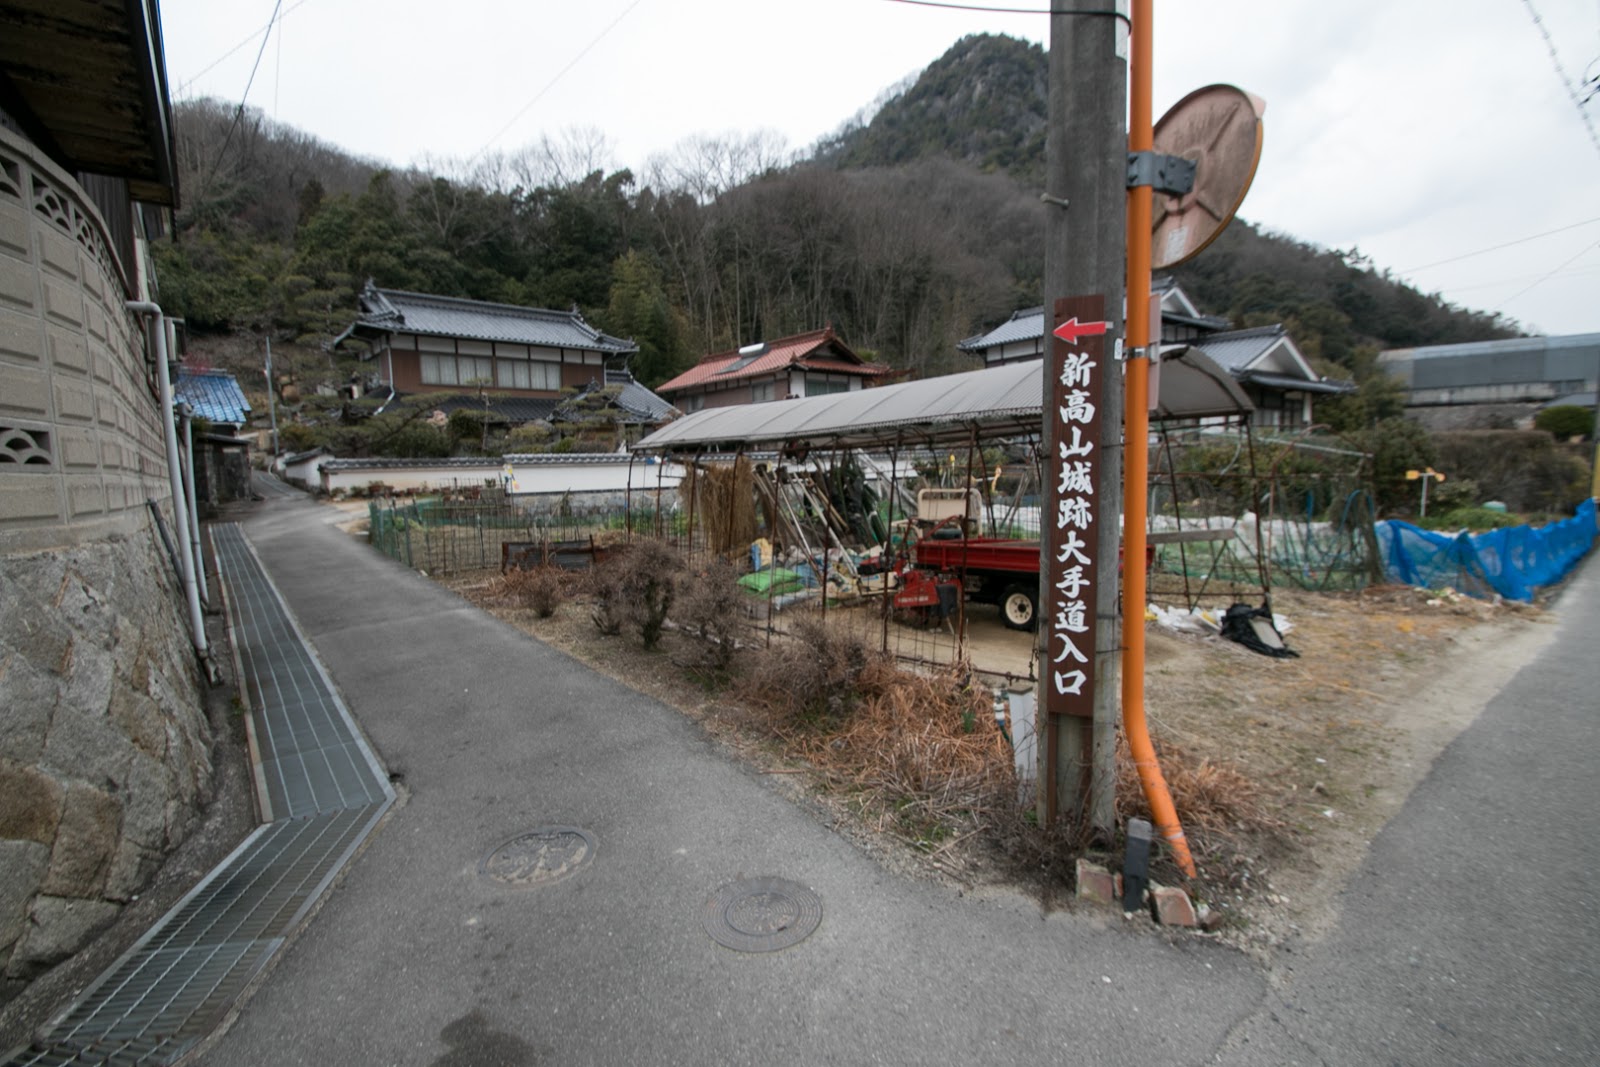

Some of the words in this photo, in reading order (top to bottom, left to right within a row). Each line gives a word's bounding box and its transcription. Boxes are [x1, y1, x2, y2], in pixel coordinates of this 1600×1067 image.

[1054, 352, 1096, 696] 新高山城跡大手道入口
